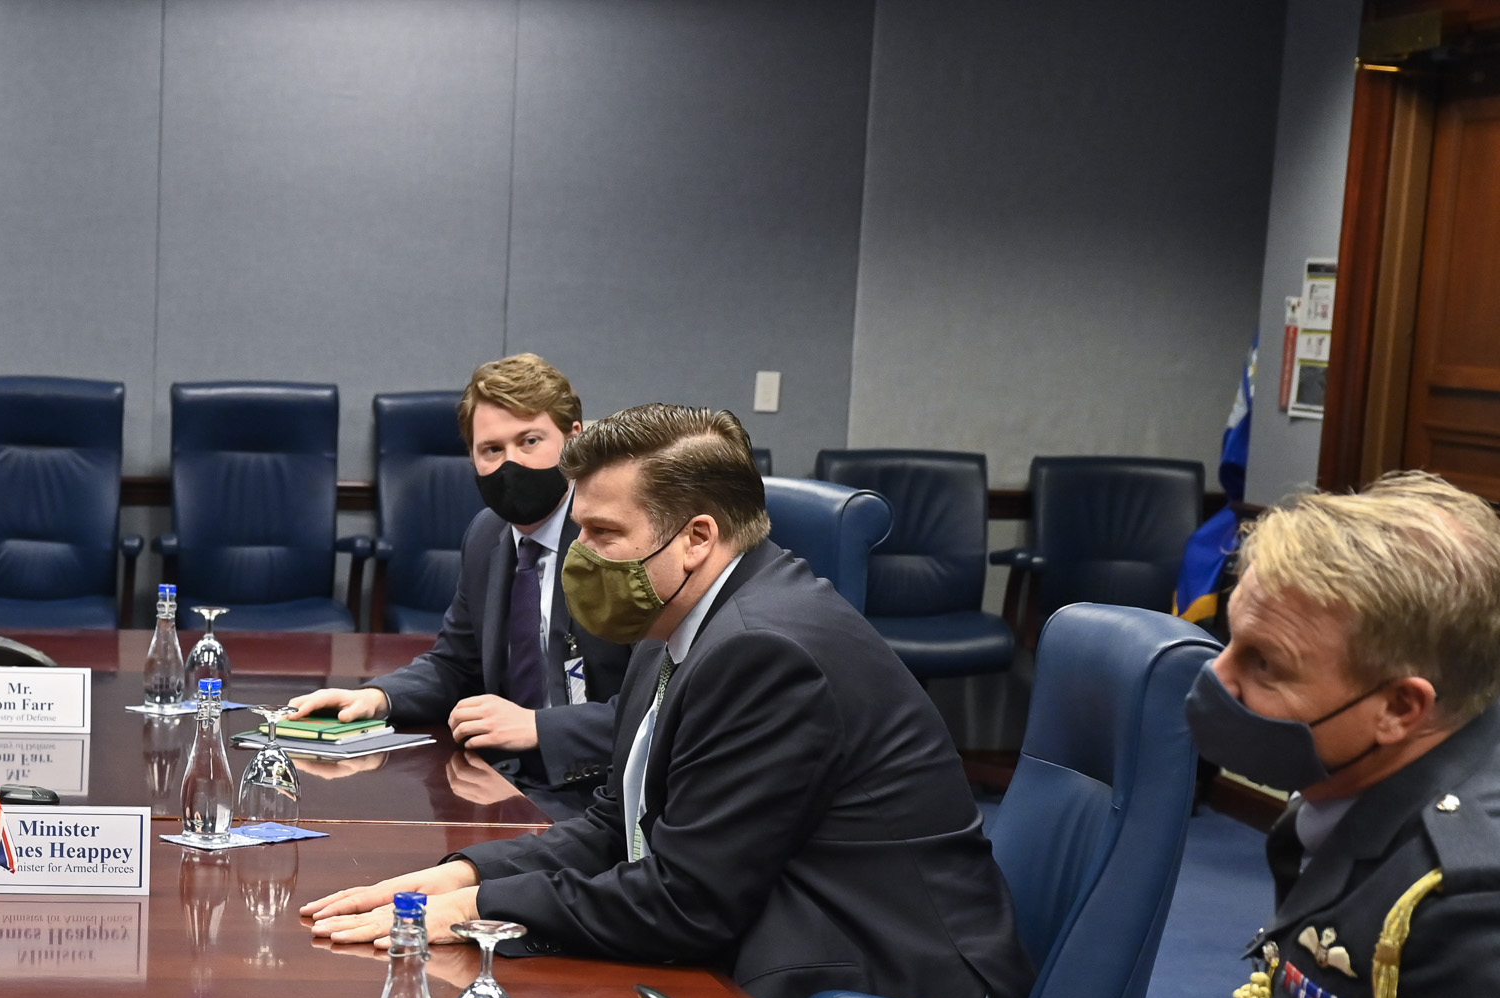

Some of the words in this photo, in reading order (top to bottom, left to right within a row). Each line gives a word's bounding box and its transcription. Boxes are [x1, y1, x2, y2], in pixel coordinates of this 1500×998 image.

[7, 683, 32, 695] Mr.
[22, 698, 54, 711] Farr
[15, 714, 25, 722] of
[26, 714, 57, 722] Defense
[19, 819, 100, 838] Minister
[50, 842, 133, 864] Heappey
[3, 862, 45, 872] nister
[48, 862, 63, 873] for
[65, 863, 99, 873] Armed
[101, 864, 134, 874] Forces
